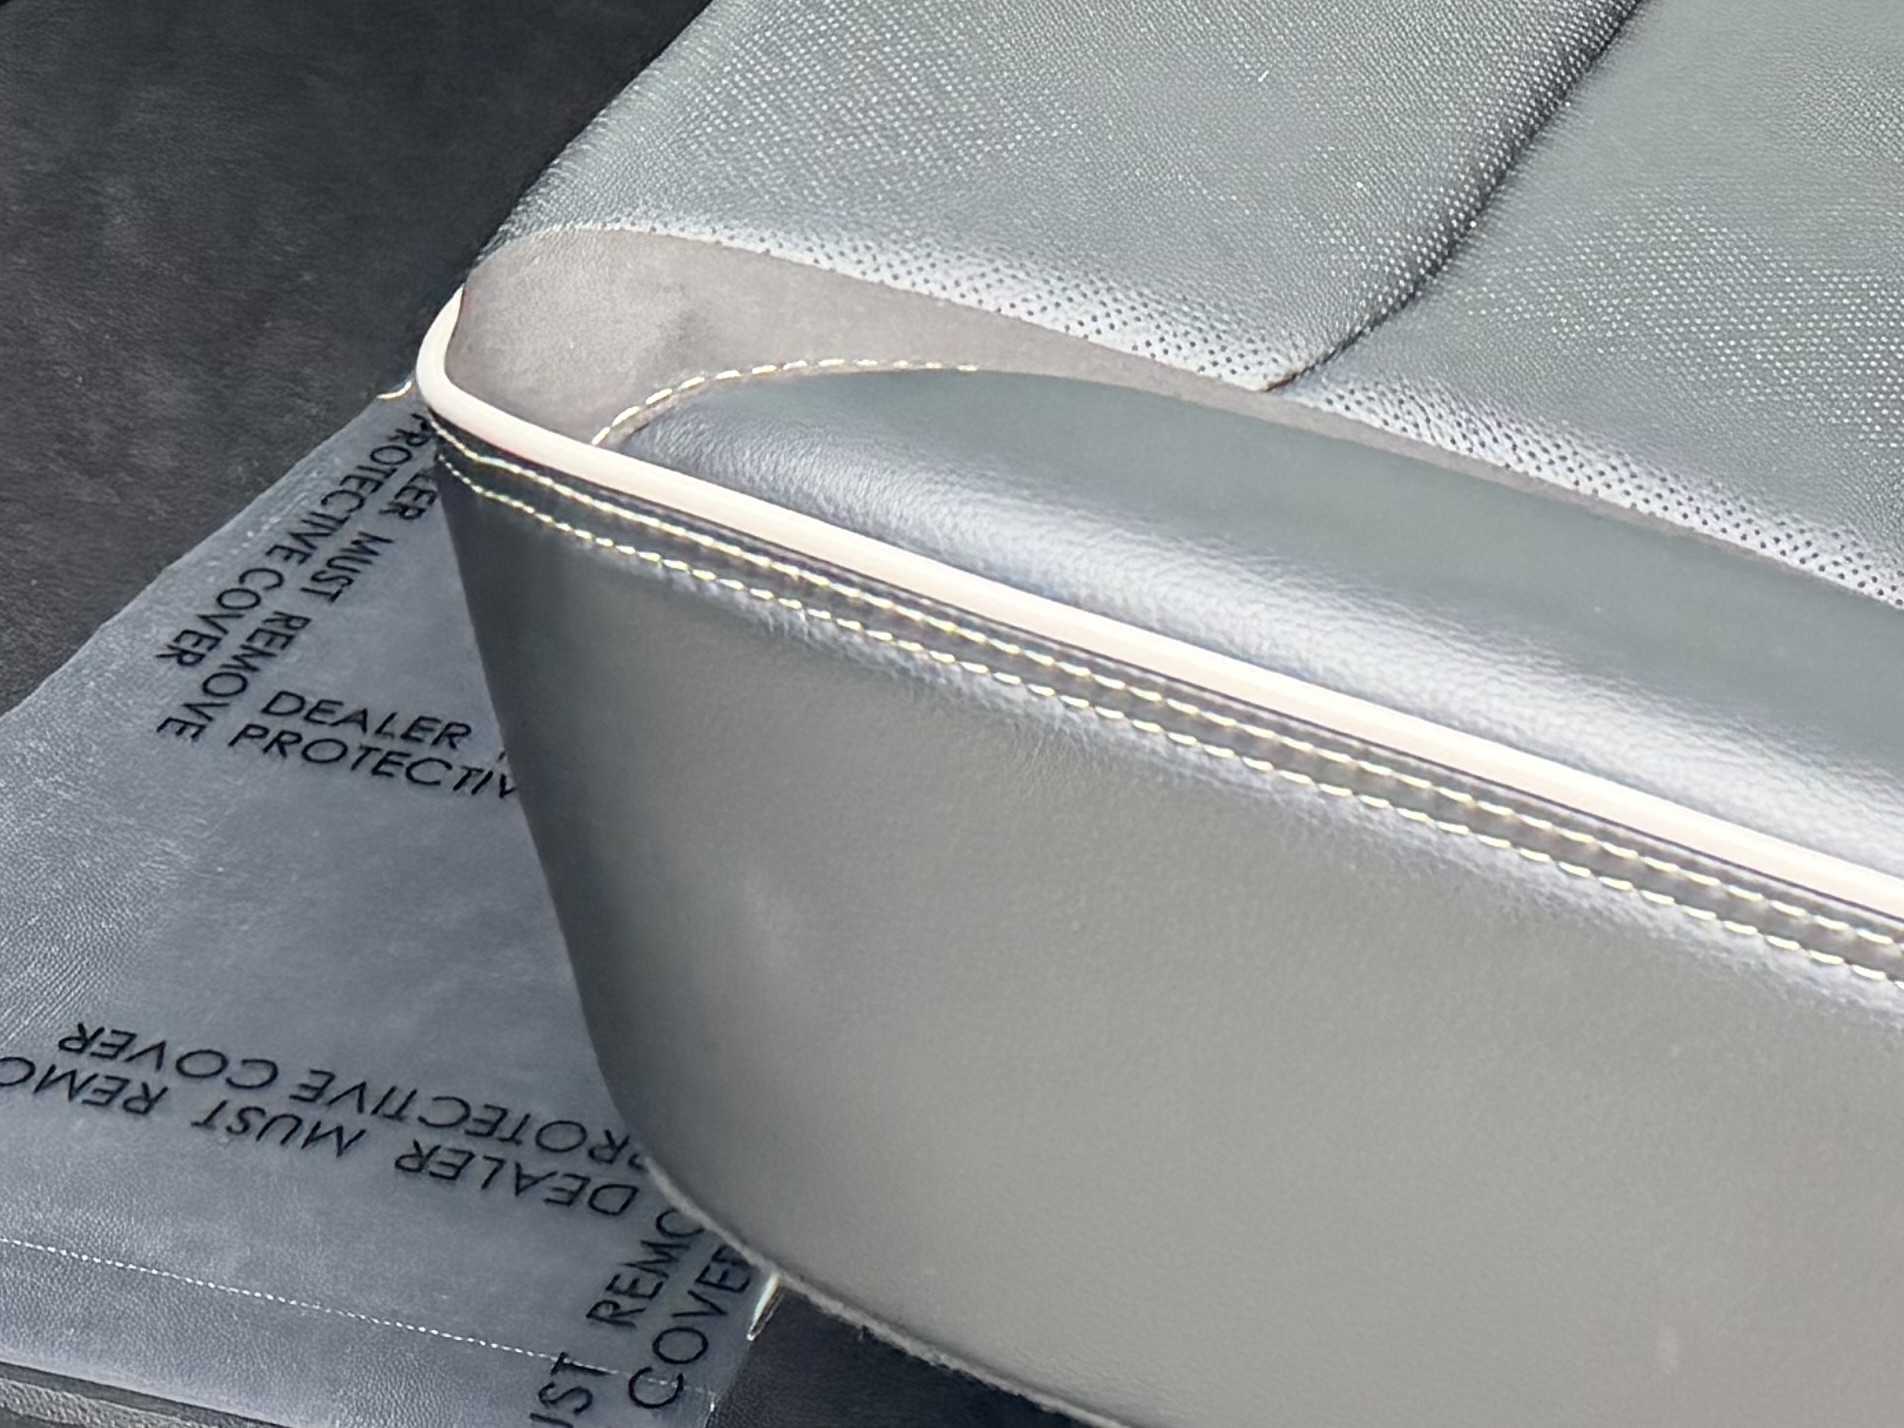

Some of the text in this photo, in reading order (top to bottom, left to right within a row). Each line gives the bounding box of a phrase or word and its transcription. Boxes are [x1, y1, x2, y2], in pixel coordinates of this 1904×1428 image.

[300, 530, 395, 604] MUST
[155, 566, 285, 668] COVER
[156, 609, 313, 742] REMOVE
[261, 689, 473, 750] DEALER
[227, 721, 518, 799] PROTECTIV
[58, 1022, 278, 1090] COVER
[190, 1099, 367, 1159] MUST
[395, 1139, 640, 1217] DEALER
[529, 1207, 705, 1428] ST REMO
